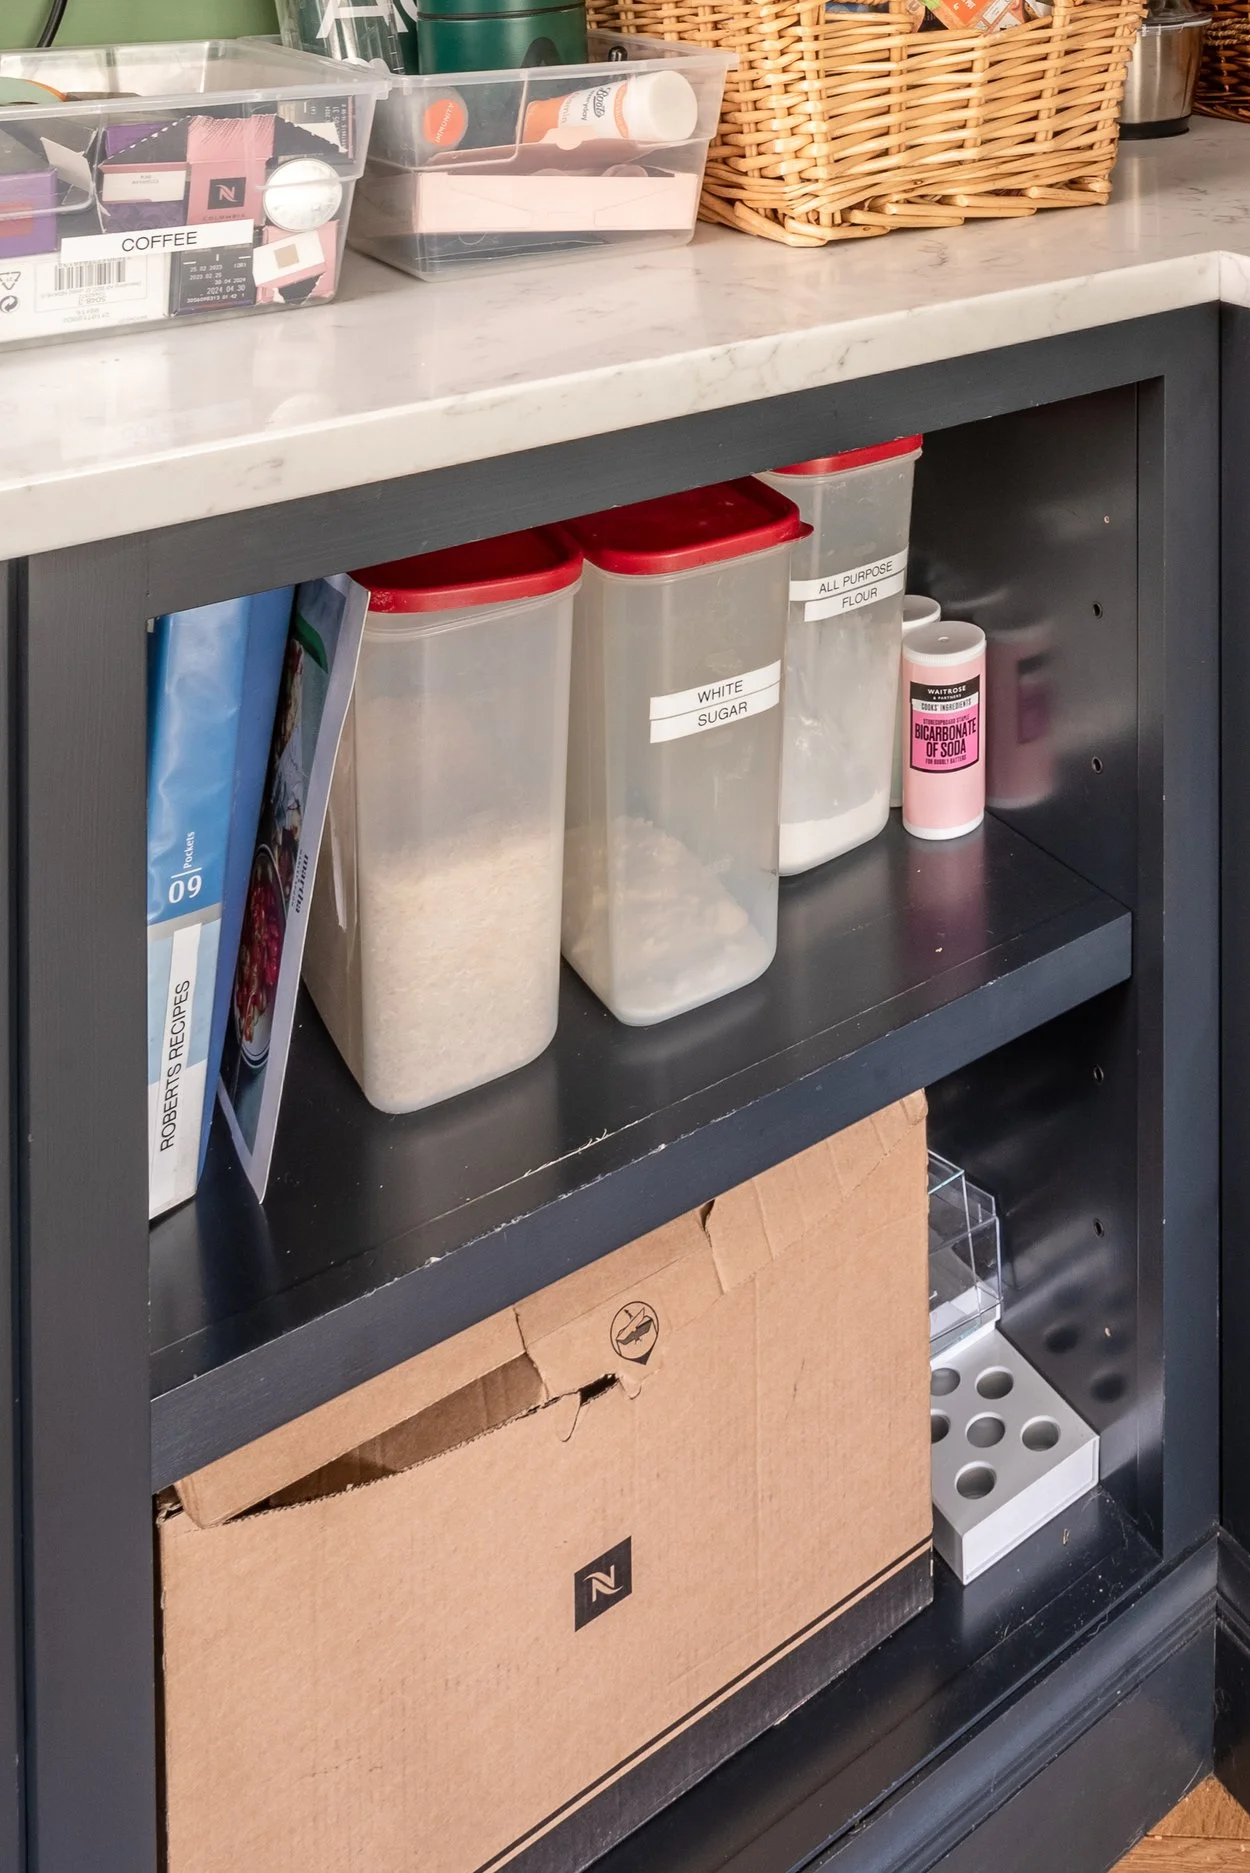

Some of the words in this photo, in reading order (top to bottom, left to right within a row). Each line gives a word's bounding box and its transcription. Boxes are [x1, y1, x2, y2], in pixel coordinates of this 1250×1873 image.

[435, 102, 454, 143] IMMUNITY
[121, 230, 198, 255] COFFEE
[818, 582, 840, 594] ALL
[842, 560, 893, 587] PURPOSE
[841, 587, 878, 609] FLOUR
[697, 679, 744, 704] WHITE
[927, 685, 967, 695] WAITROSE
[697, 701, 748, 727] SUGAR
[939, 698, 972, 712] INGREDIENTS
[914, 716, 977, 742] BICARBONATE
[926, 742, 939, 757] OF
[940, 738, 967, 758] SODA
[182, 831, 196, 869] Pockets
[168, 874, 203, 905] 09
[295, 853, 309, 914] martha
[168, 979, 191, 1062] RECIPES
[160, 1063, 183, 1153] ROBERTS
[582, 1564, 624, 1603] N
